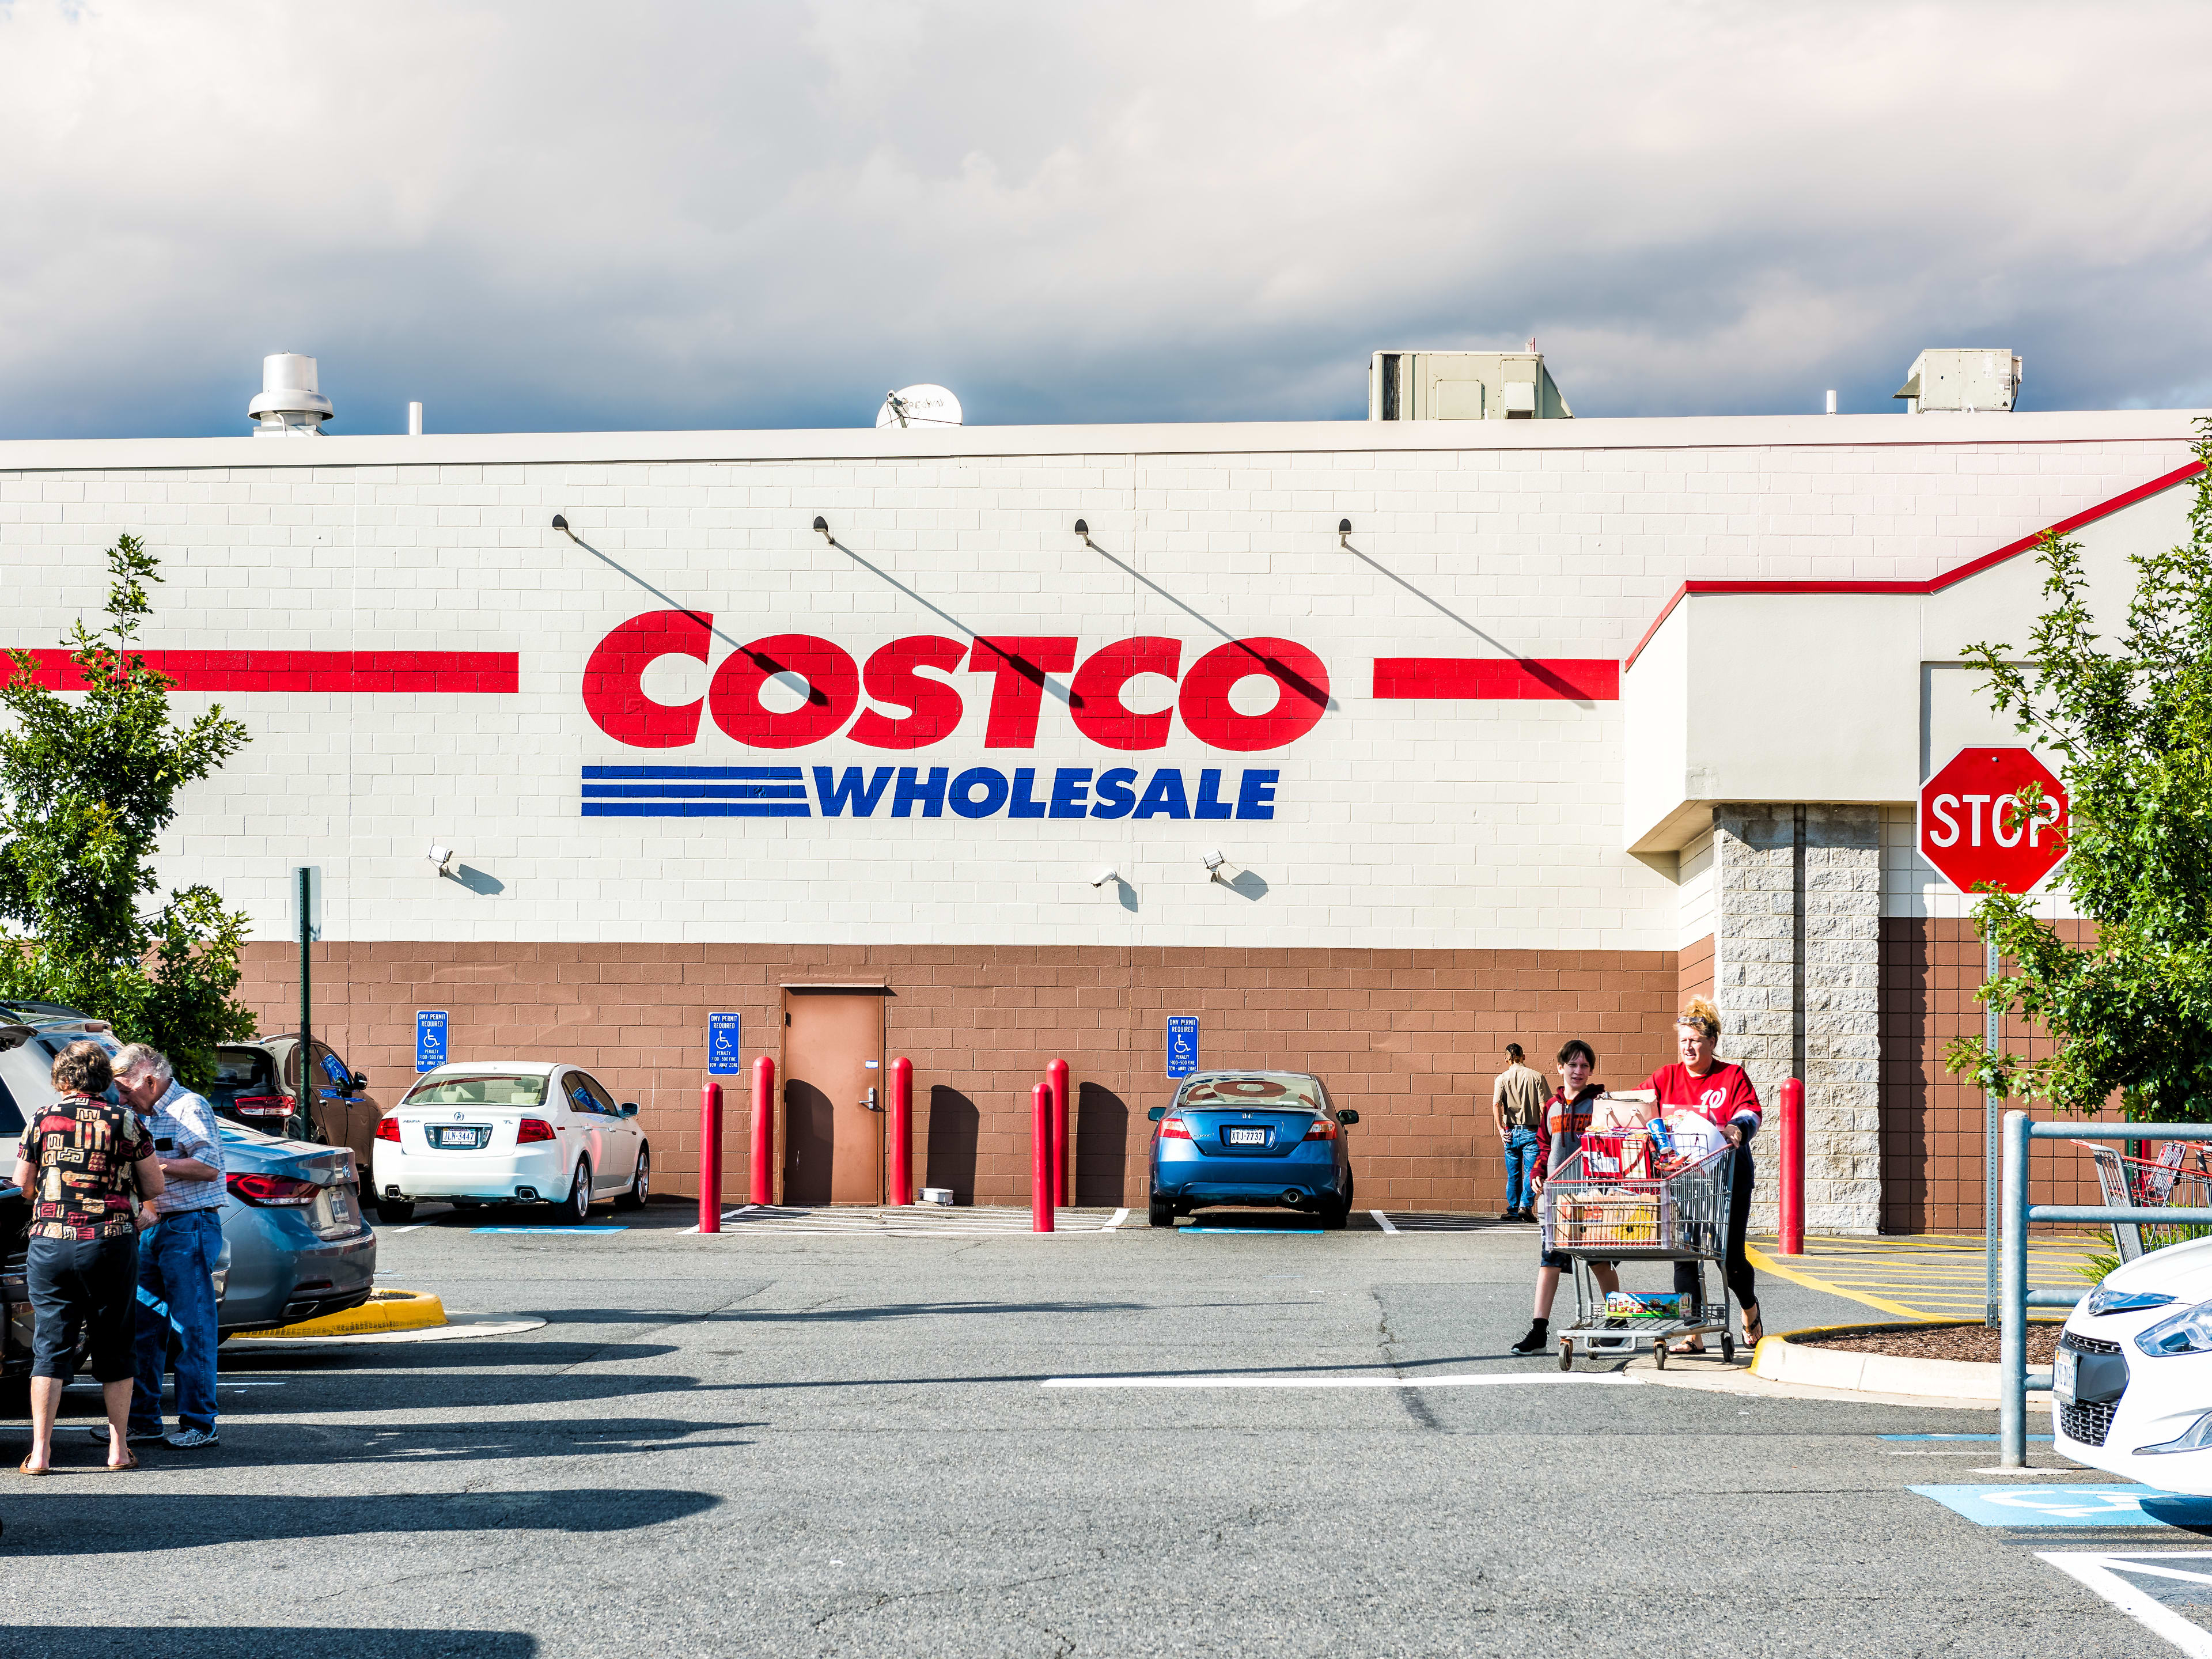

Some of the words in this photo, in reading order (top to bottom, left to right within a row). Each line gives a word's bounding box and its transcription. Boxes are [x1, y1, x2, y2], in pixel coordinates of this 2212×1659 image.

[582, 609, 1330, 751] COSTCO
[812, 767, 1279, 820] WHOLESALE
[1929, 793, 2060, 848] STOP
[444, 1132, 474, 1141] JLN-3447
[1232, 1132, 1263, 1141] XTJ-7737
